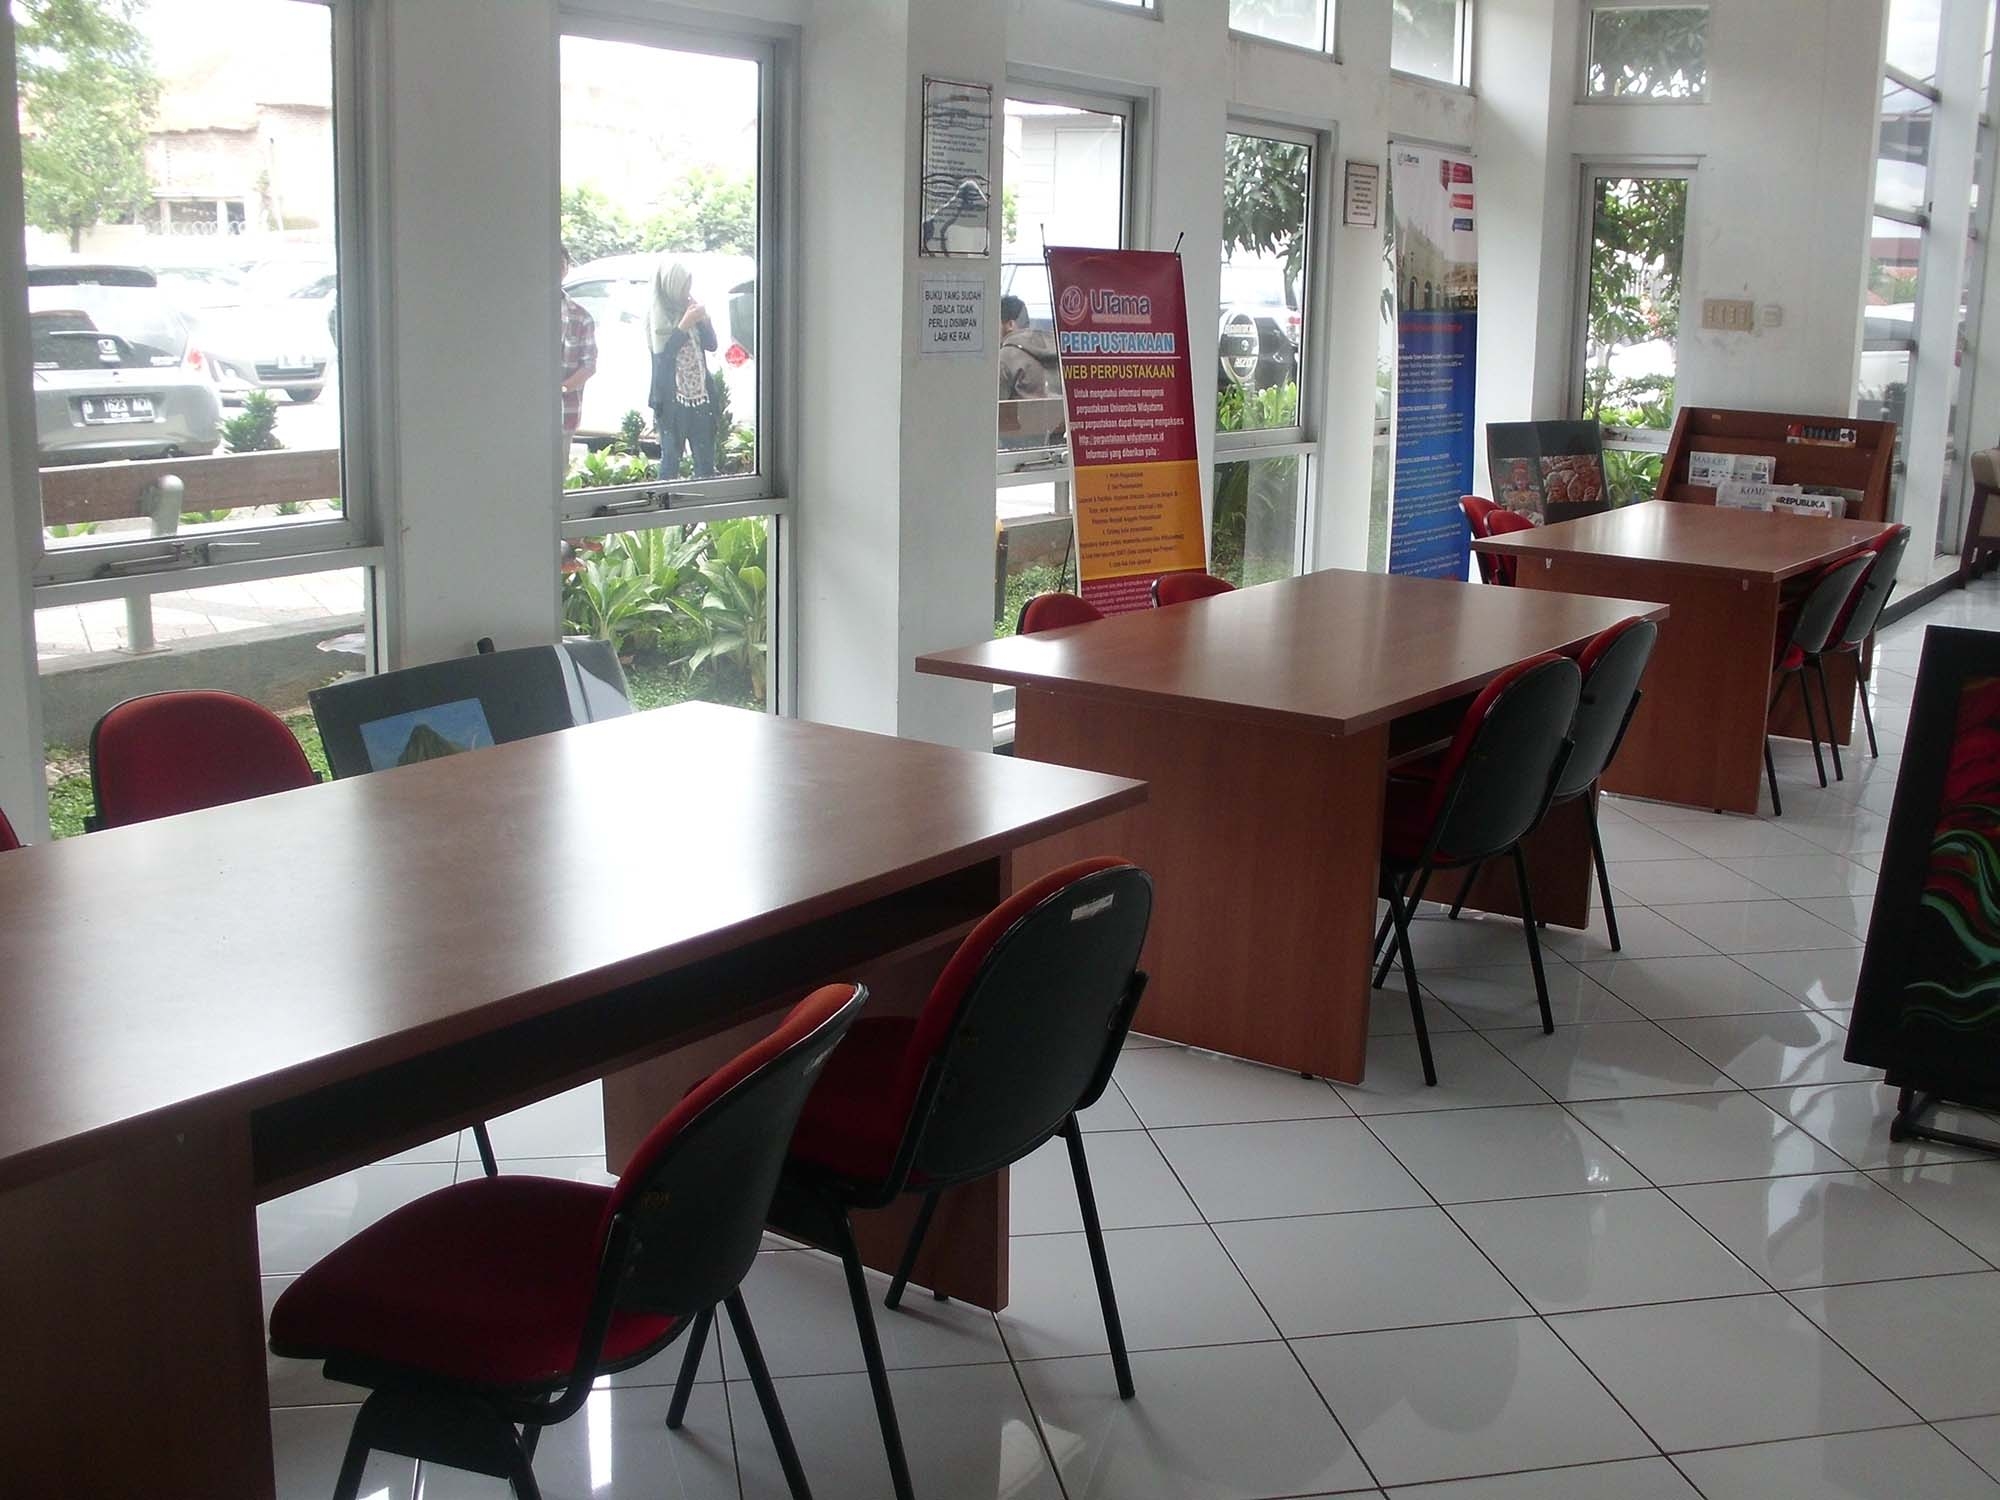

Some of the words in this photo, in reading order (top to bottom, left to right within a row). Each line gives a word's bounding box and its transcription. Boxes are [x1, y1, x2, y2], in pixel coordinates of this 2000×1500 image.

[925, 290, 942, 301] BUKU
[944, 290, 960, 301] YANG
[961, 290, 982, 301] SUDAH
[1090, 289, 1151, 315] UTama
[932, 304, 955, 314] DIBACA
[956, 304, 974, 314] TIDAK
[928, 318, 948, 328] PERLU
[949, 318, 977, 328] DISIMPAN
[934, 331, 948, 341] LAGI
[949, 331, 957, 341] KE
[958, 331, 971, 341] RAK
[1060, 331, 1175, 354] PERPUSTAKAAN
[1063, 365, 1088, 380] WEB
[1090, 364, 1175, 379] PERPUSTAKAAN
[1780, 495, 1827, 510] REPUBLIKA
